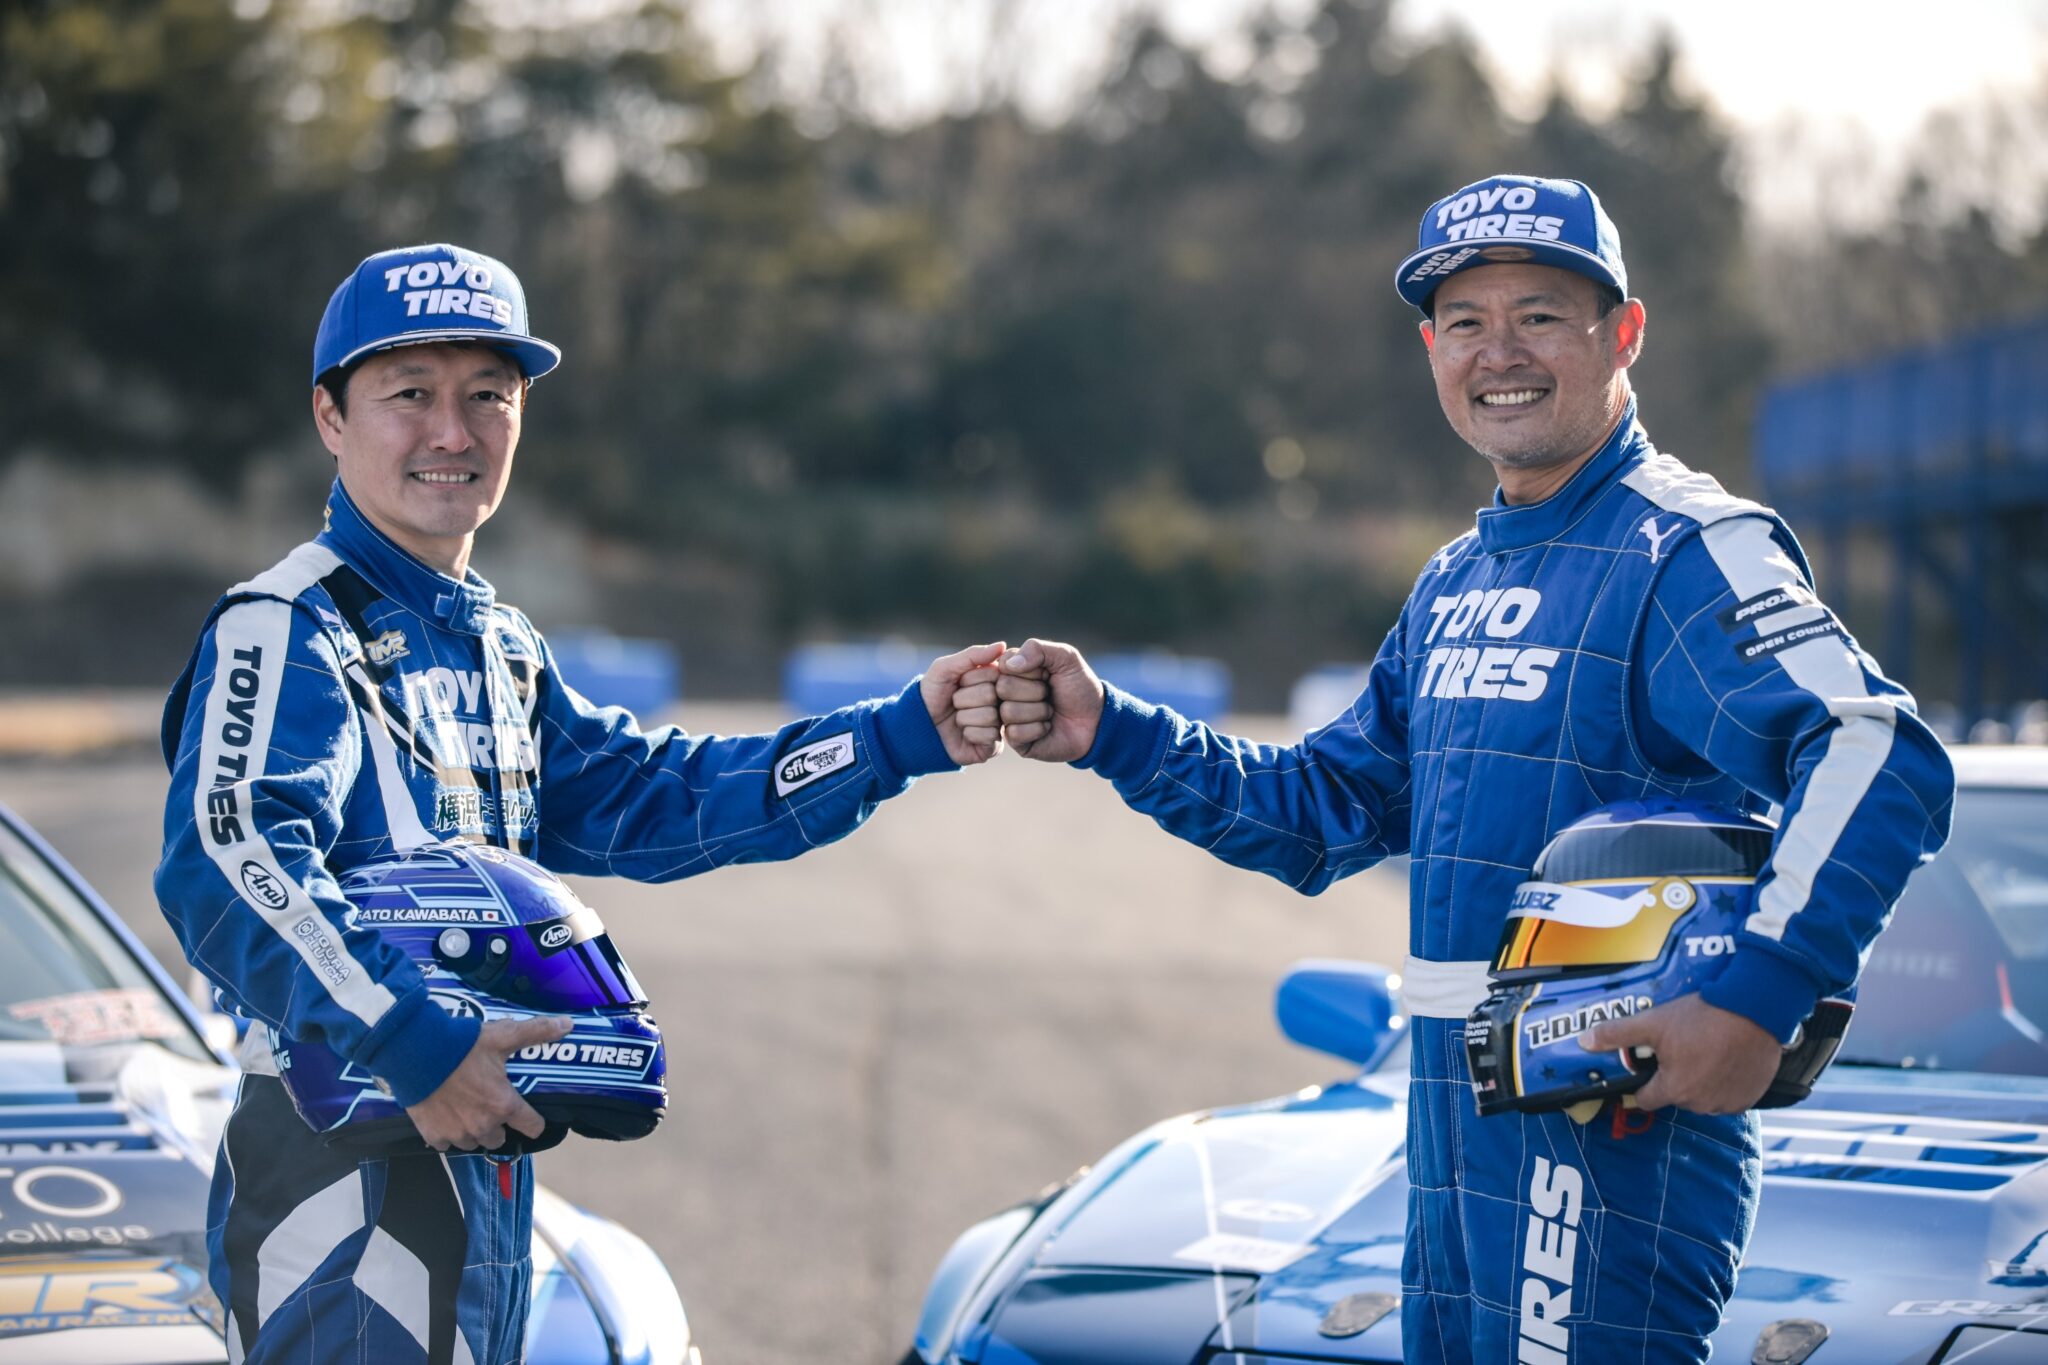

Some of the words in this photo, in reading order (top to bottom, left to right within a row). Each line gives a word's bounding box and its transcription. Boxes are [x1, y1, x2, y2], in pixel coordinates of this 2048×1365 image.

[1436, 187, 1537, 229] TOYO
[1446, 213, 1565, 242] TIRES
[384, 261, 493, 292] TOYO
[1405, 251, 1452, 284] TOYO
[1430, 246, 1482, 276] TIRES
[403, 288, 513, 327] TIRES
[1423, 586, 1542, 645] TOYO
[1735, 592, 1795, 621] PROX
[1745, 636, 1786, 657] OPEN
[1787, 620, 1840, 641] COUNT
[1419, 646, 1561, 702] TIRES
[221, 645, 263, 748] TOYO
[207, 753, 248, 846] TIES
[241, 867, 288, 905] Arai
[394, 909, 479, 921] KAWABATA
[543, 926, 569, 945] Arai
[580, 1044, 645, 1067] TIRES
[1518, 1155, 1583, 1365] IRES
